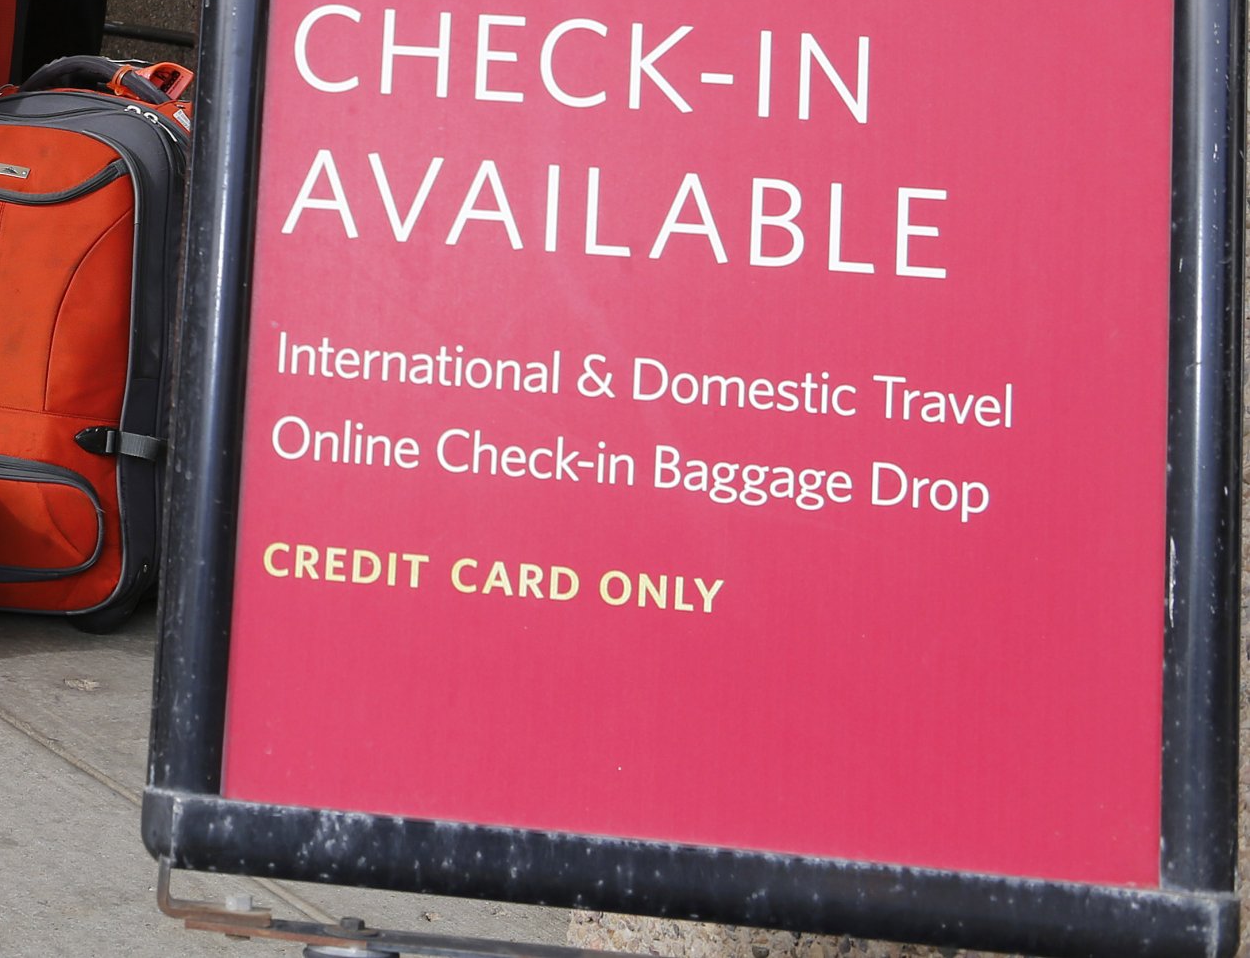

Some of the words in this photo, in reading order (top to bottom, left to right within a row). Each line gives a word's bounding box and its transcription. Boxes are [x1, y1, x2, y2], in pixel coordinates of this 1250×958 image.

[293, 3, 870, 124] CHECK-IN
[281, 148, 948, 279] AVAILABLE
[278, 331, 562, 395] International
[577, 353, 616, 399] &
[633, 357, 857, 417] Domestic
[872, 375, 1013, 429] Travel
[271, 415, 420, 470] Online
[436, 428, 634, 487] Check-in
[653, 444, 852, 511] Baggage
[872, 462, 989, 522] Drop
[263, 542, 430, 589] CREDIT
[450, 558, 579, 601] CARD
[600, 570, 725, 613] ONLY
